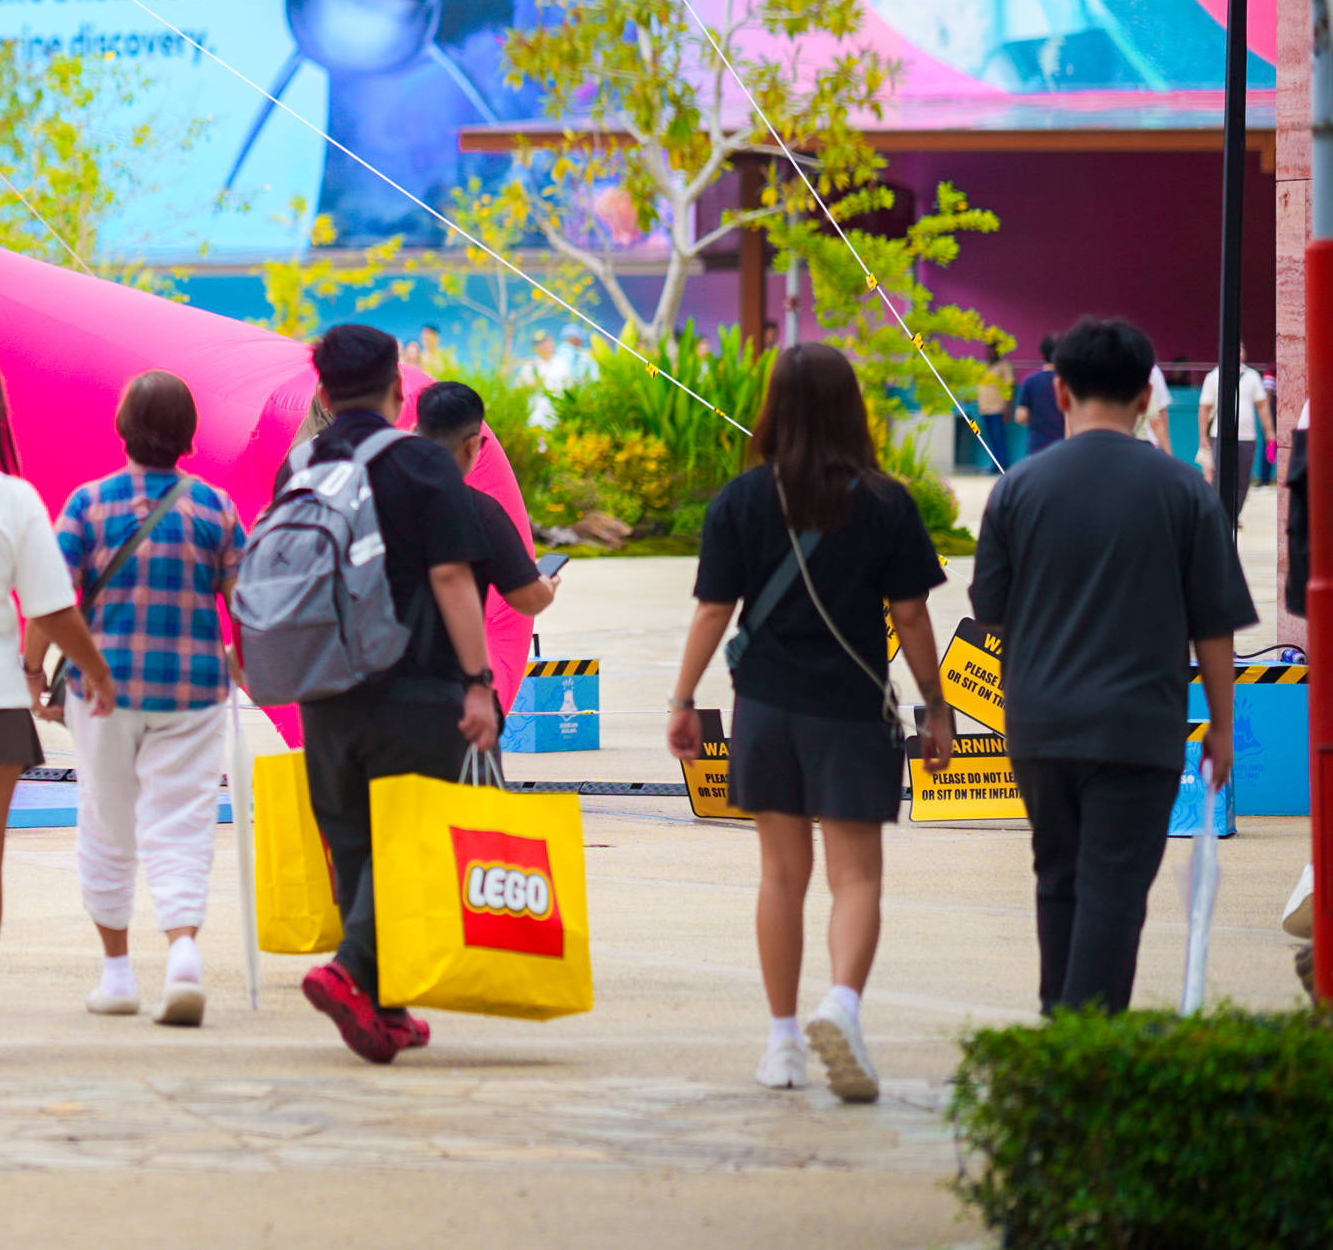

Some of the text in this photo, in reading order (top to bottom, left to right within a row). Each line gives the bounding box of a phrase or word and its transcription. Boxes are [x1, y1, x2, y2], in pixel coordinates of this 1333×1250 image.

[964, 661, 998, 687] PLEASE
[947, 669, 1005, 708] OR SIT ON TH
[937, 738, 1008, 754] ARNIN
[705, 773, 727, 784] PLEA
[933, 771, 1015, 785] PLEASE DO NOT LE
[698, 786, 727, 798] OR SIT
[922, 787, 1022, 801] OR SIT ON THE INFLAT
[468, 865, 550, 917] LEGO
